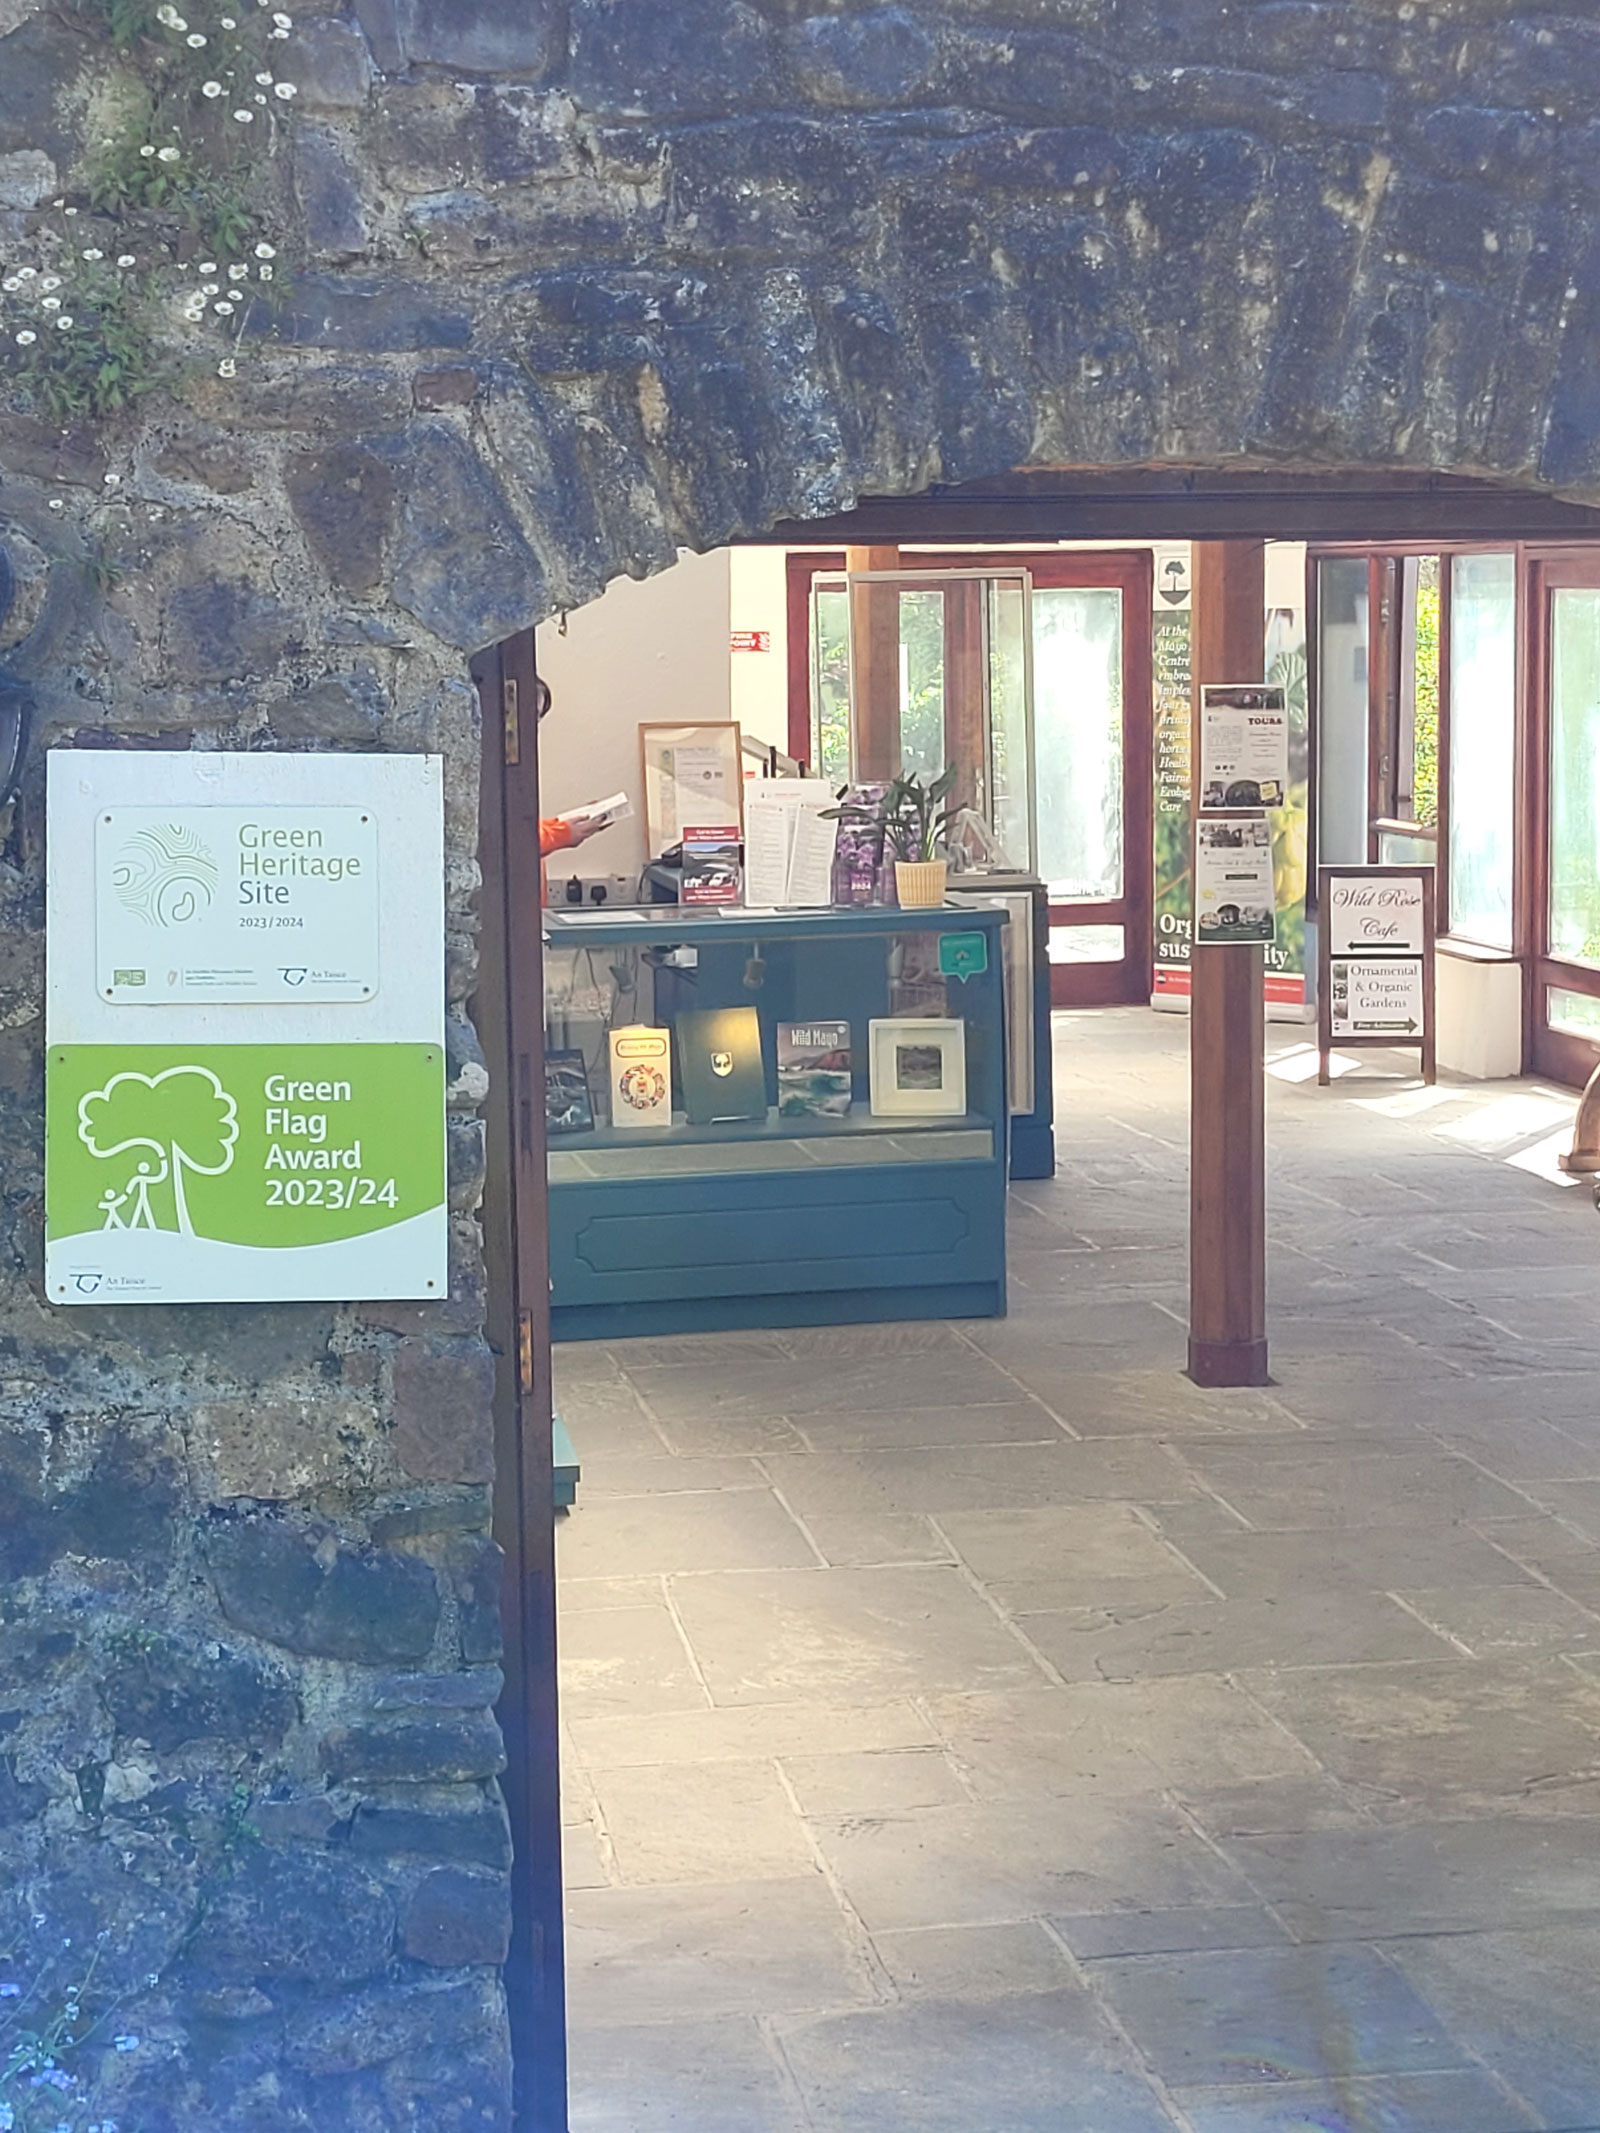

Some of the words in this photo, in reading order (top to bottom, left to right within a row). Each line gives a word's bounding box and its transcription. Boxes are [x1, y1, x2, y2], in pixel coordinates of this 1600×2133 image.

[1172, 624, 1188, 637] the
[1158, 641, 1187, 654] Mayo
[1248, 717, 1283, 725] TOURS
[1159, 801, 1181, 812] Care
[238, 824, 323, 849] Green
[238, 852, 362, 881] Heritage
[238, 880, 290, 905] Site
[1333, 886, 1373, 908] Wild
[1378, 888, 1420, 908] Rose
[1360, 917, 1398, 940] Cafe
[1350, 965, 1418, 977] Ornamental
[1355, 982, 1364, 992] &
[1368, 981, 1413, 993] Organic
[1360, 997, 1407, 1008] Gardens
[791, 1028, 811, 1046] Wild
[813, 1029, 838, 1049] Mayo
[264, 1074, 352, 1102] Green
[264, 1108, 328, 1143] Flag
[263, 1140, 362, 1171] Award
[264, 1177, 399, 1210] 2023/24
